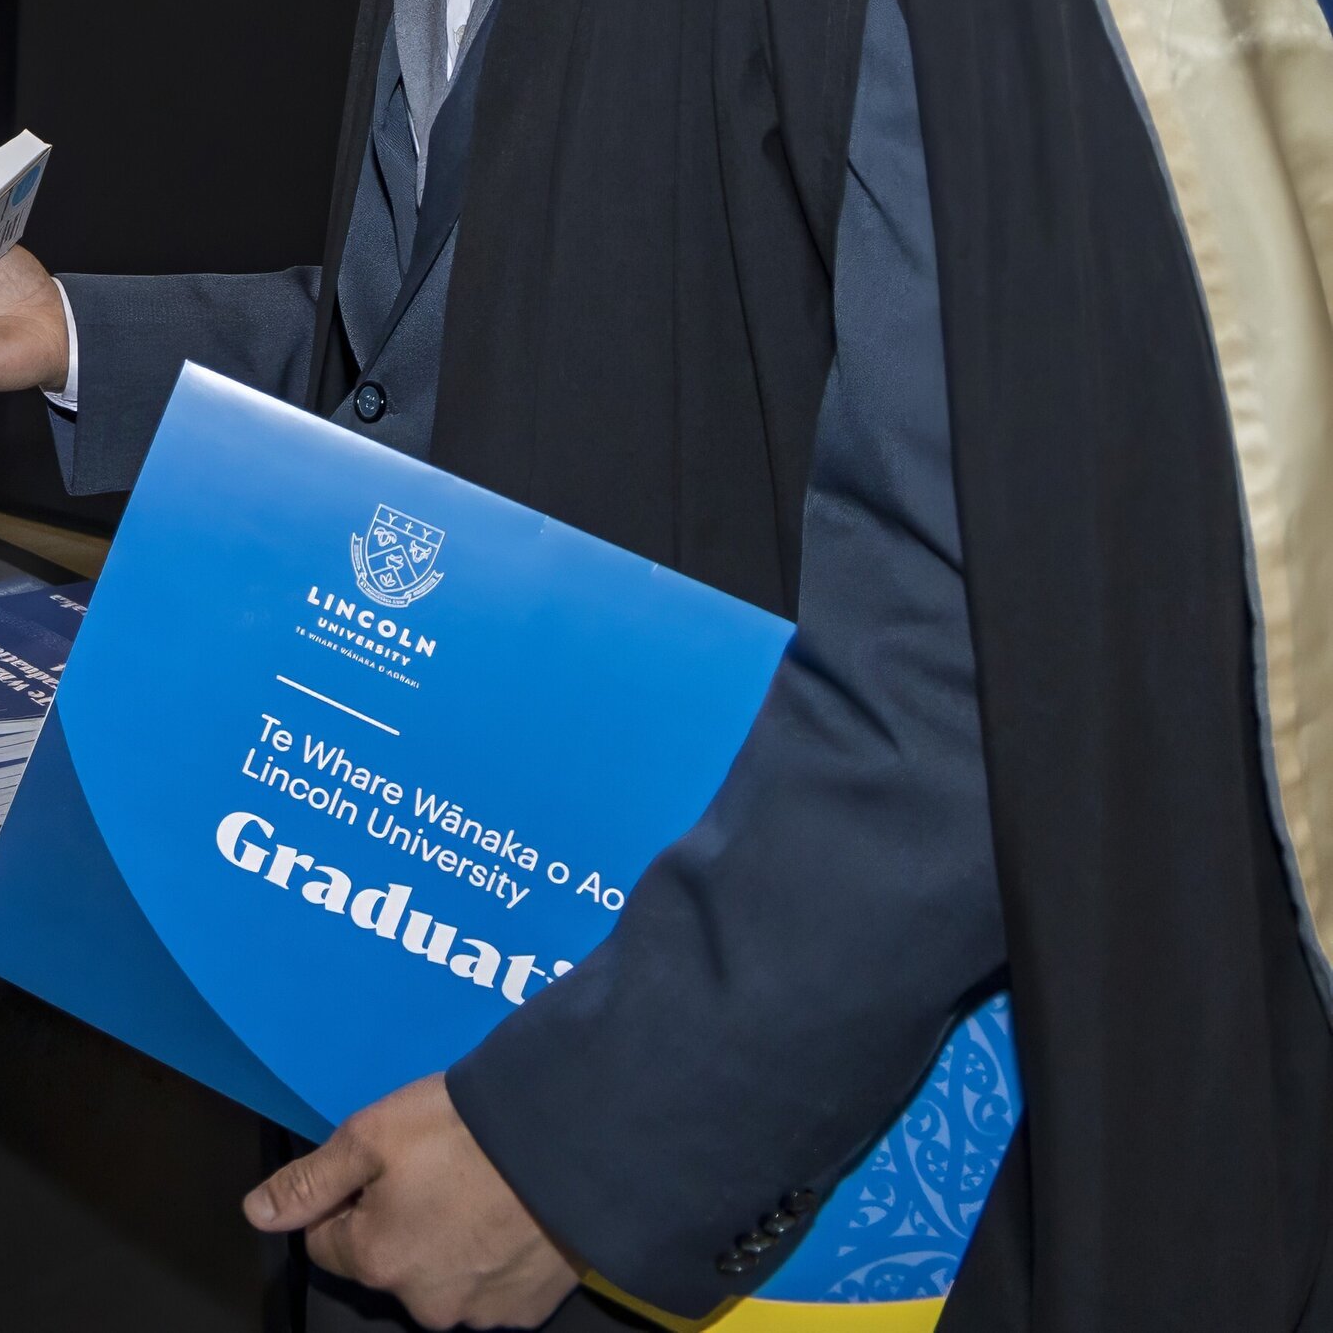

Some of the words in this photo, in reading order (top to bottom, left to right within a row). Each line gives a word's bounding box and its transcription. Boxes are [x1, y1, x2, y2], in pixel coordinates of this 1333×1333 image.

[306, 586, 437, 657] LINCOLN
[317, 617, 412, 666] UNIVERSITY
[241, 748, 359, 825] Lincoln
[367, 807, 531, 910] University
[260, 713, 293, 752] Te
[303, 734, 404, 805] Whare
[414, 787, 539, 872] Wānaka
[547, 861, 570, 884] o
[576, 872, 626, 911] Ao
